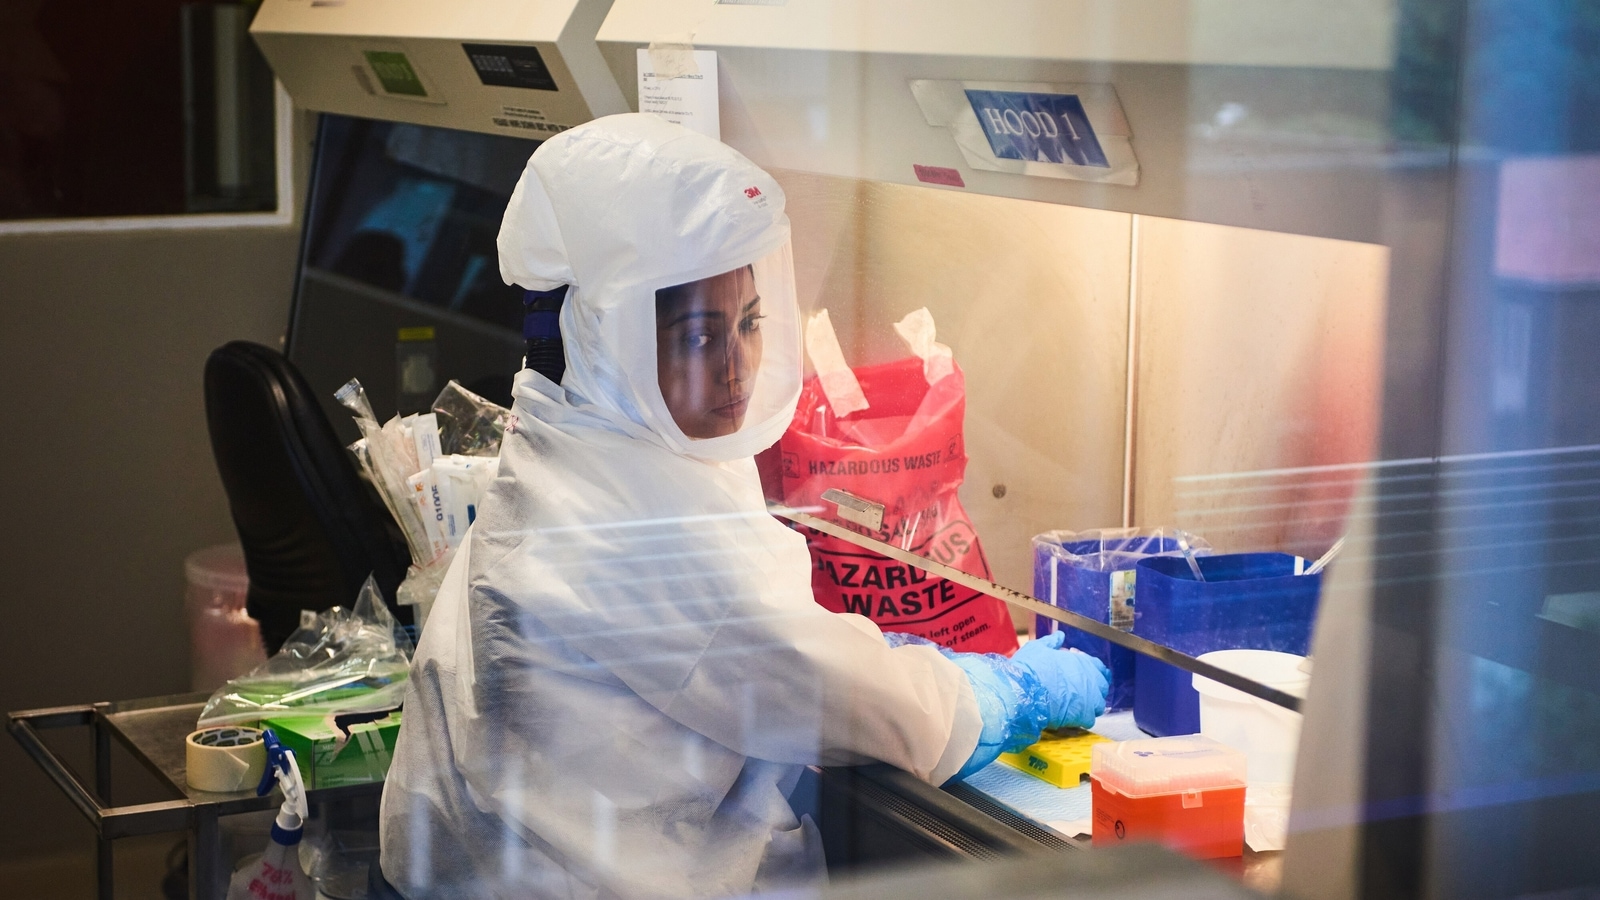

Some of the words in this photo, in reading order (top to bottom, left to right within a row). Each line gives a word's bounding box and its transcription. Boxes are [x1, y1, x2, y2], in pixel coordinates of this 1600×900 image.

[984, 108, 1058, 138] HOOD
[1061, 113, 1081, 140] 1
[744, 186, 762, 199] 3M
[808, 457, 900, 475] HAZARDOUS
[903, 451, 942, 471] WASTE
[842, 578, 956, 618] WASTE
[930, 627, 950, 638] left
[953, 615, 976, 632] open
[946, 636, 959, 646] of
[961, 623, 991, 642] steam.
[262, 862, 293, 884] 70%
